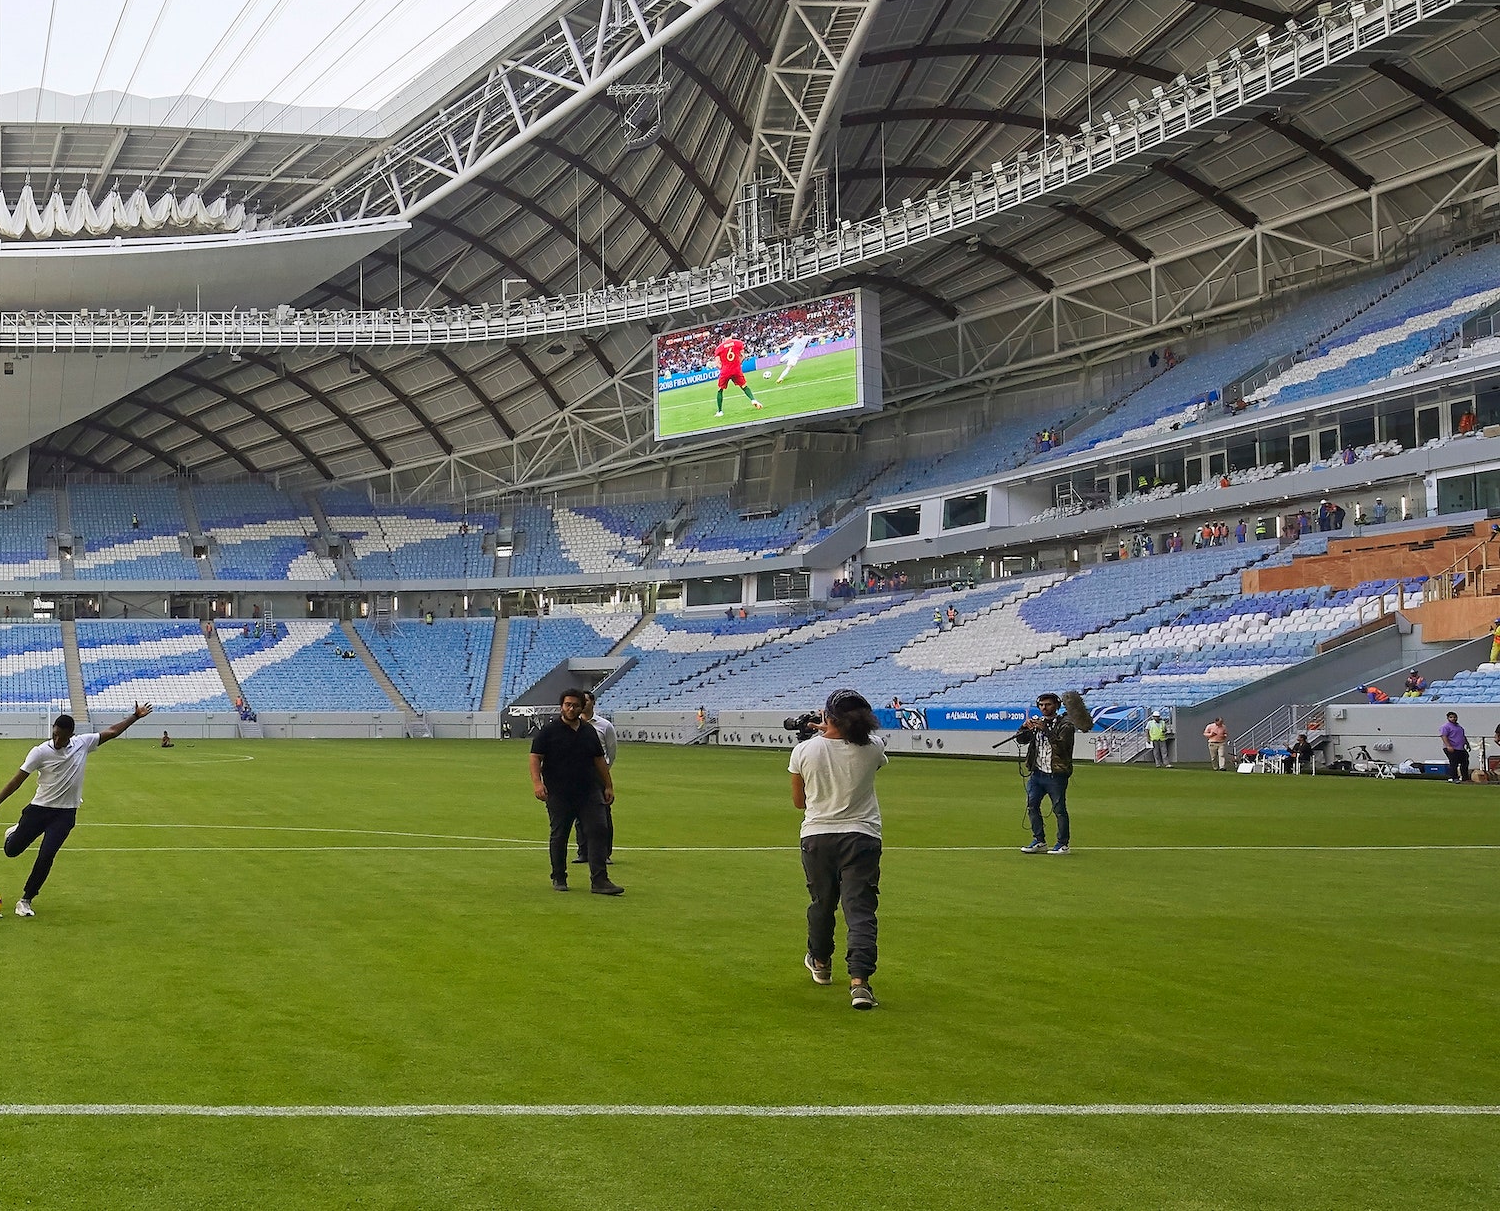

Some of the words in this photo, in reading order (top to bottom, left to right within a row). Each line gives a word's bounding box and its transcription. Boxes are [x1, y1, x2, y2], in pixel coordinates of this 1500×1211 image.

[806, 311, 823, 320] FIFA
[726, 347, 736, 362] 6
[658, 381, 674, 391] 2018
[673, 377, 687, 387] FIFA
[686, 372, 709, 384] WORLD
[1011, 712, 1025, 720] 2019
